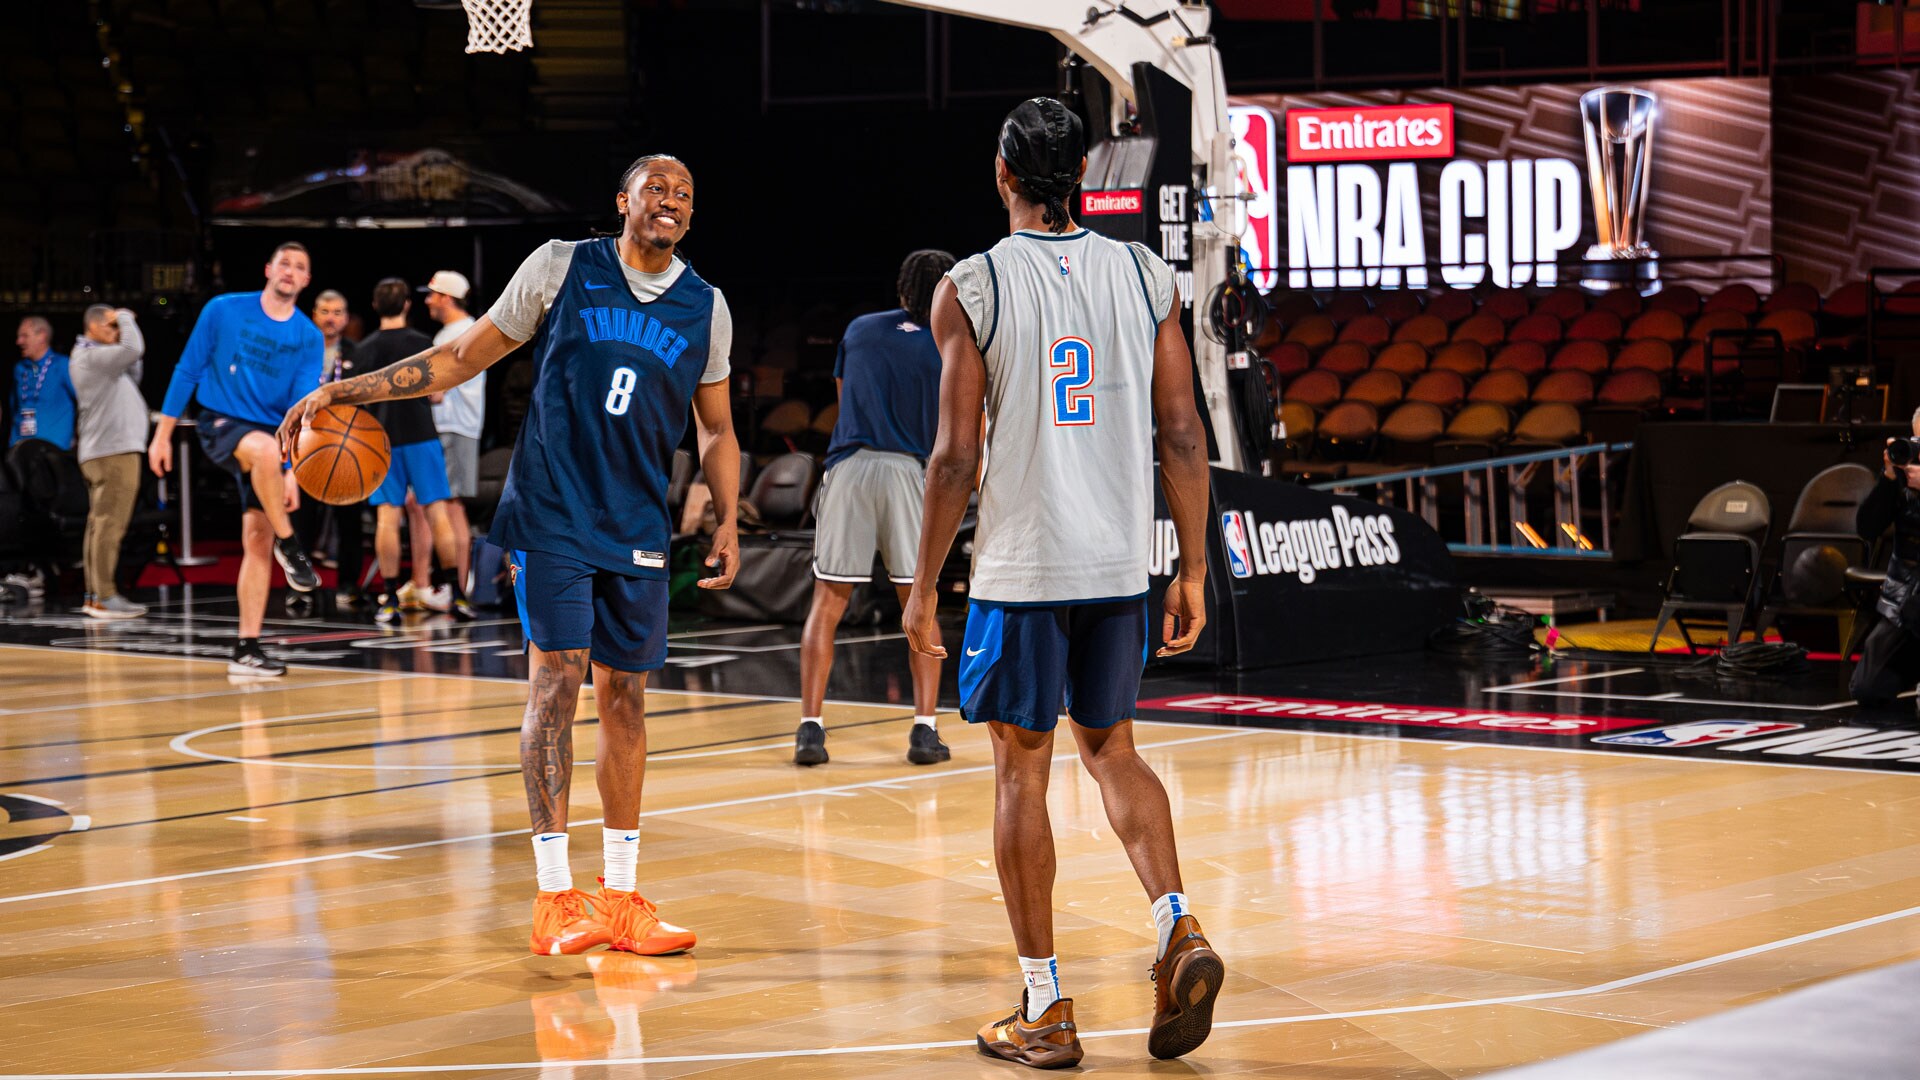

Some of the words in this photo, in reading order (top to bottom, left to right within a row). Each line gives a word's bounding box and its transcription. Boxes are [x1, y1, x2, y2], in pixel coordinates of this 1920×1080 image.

[1298, 113, 1444, 150] Emirates
[1085, 194, 1139, 212] Emirates
[1159, 184, 1188, 222] GET
[1287, 161, 1429, 290] NBA
[1440, 158, 1583, 290] CUP
[1159, 223, 1189, 260] THE
[1169, 263, 1193, 309] pp
[579, 306, 689, 369] THUNDER
[605, 366, 637, 415] 8
[1049, 335, 1095, 427] 2
[1243, 510, 1342, 584] League
[1331, 504, 1400, 567] Pass
[1165, 695, 1597, 730] Emirates
